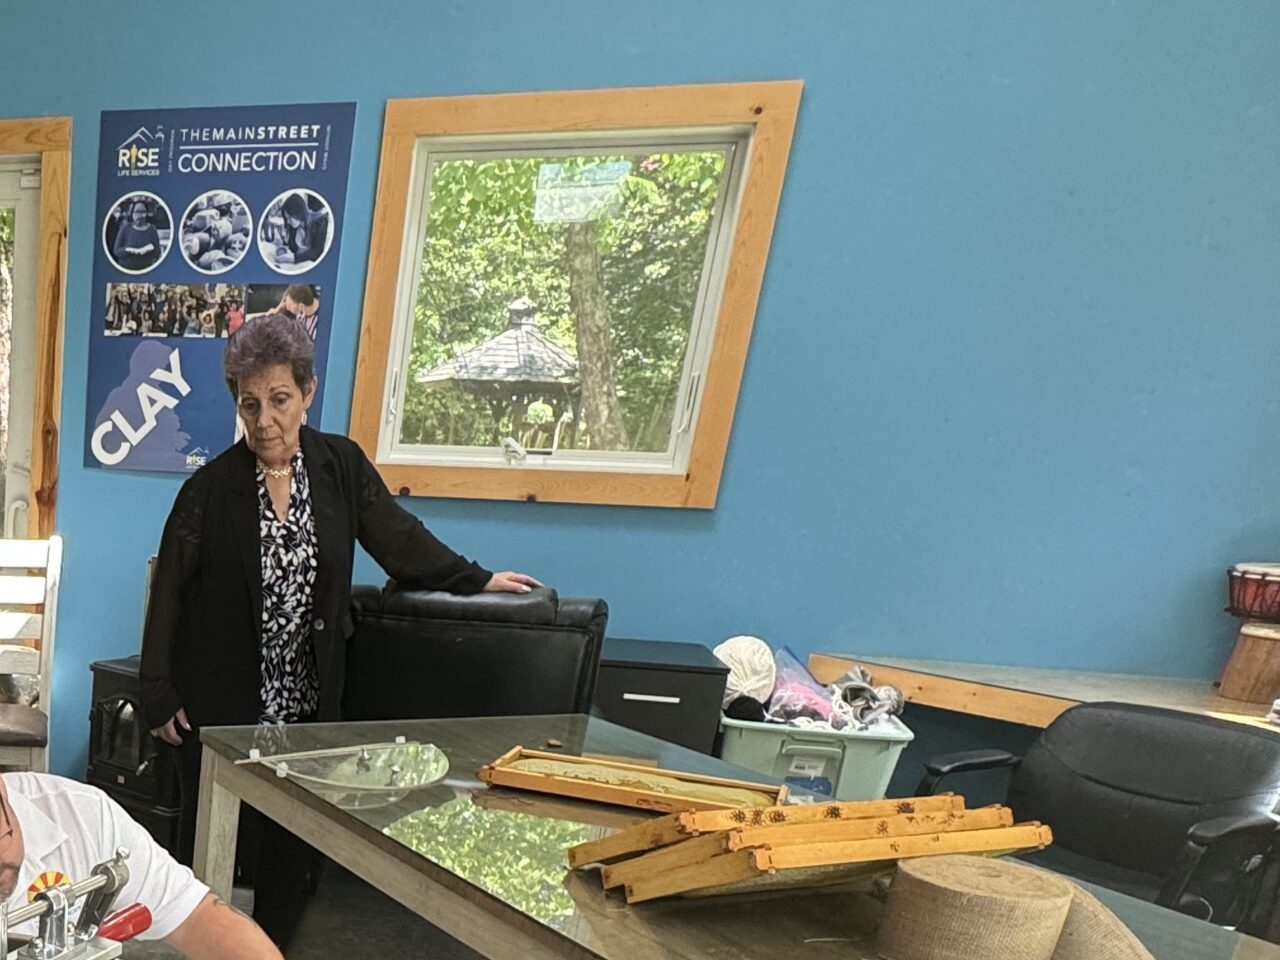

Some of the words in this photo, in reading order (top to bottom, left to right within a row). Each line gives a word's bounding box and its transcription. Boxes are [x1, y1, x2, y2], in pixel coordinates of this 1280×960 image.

[118, 144, 160, 168] RISE
[178, 150, 317, 173] CONNECTION
[91, 347, 191, 465] CLAY
